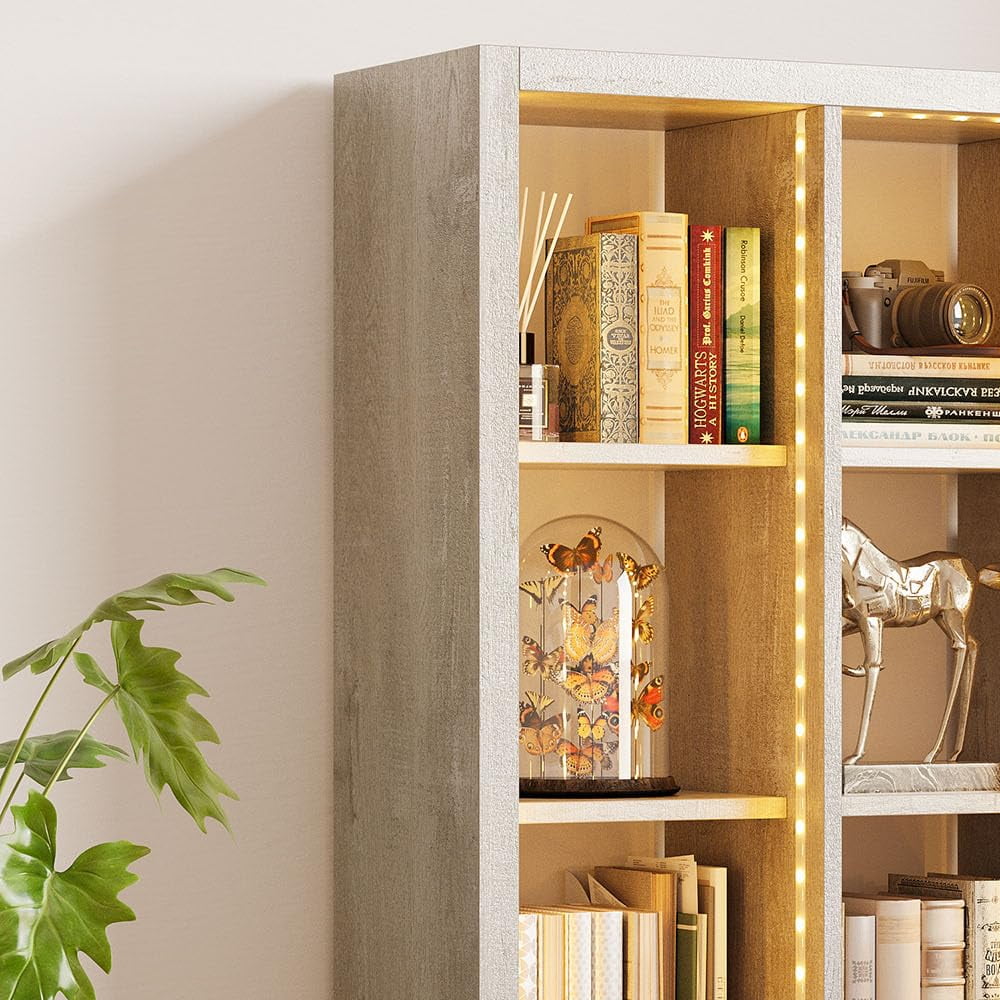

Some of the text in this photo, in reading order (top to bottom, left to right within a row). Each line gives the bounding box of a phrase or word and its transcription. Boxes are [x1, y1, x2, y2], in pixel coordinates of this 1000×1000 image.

[740, 240, 748, 302] Robinson Crusoe
[654, 307, 675, 315] ILIAD
[650, 345, 678, 354] HOMER
[694, 351, 707, 429] HOGWARTS
[709, 352, 717, 427] A HISTORY
[928, 432, 970, 442] БЛОК
